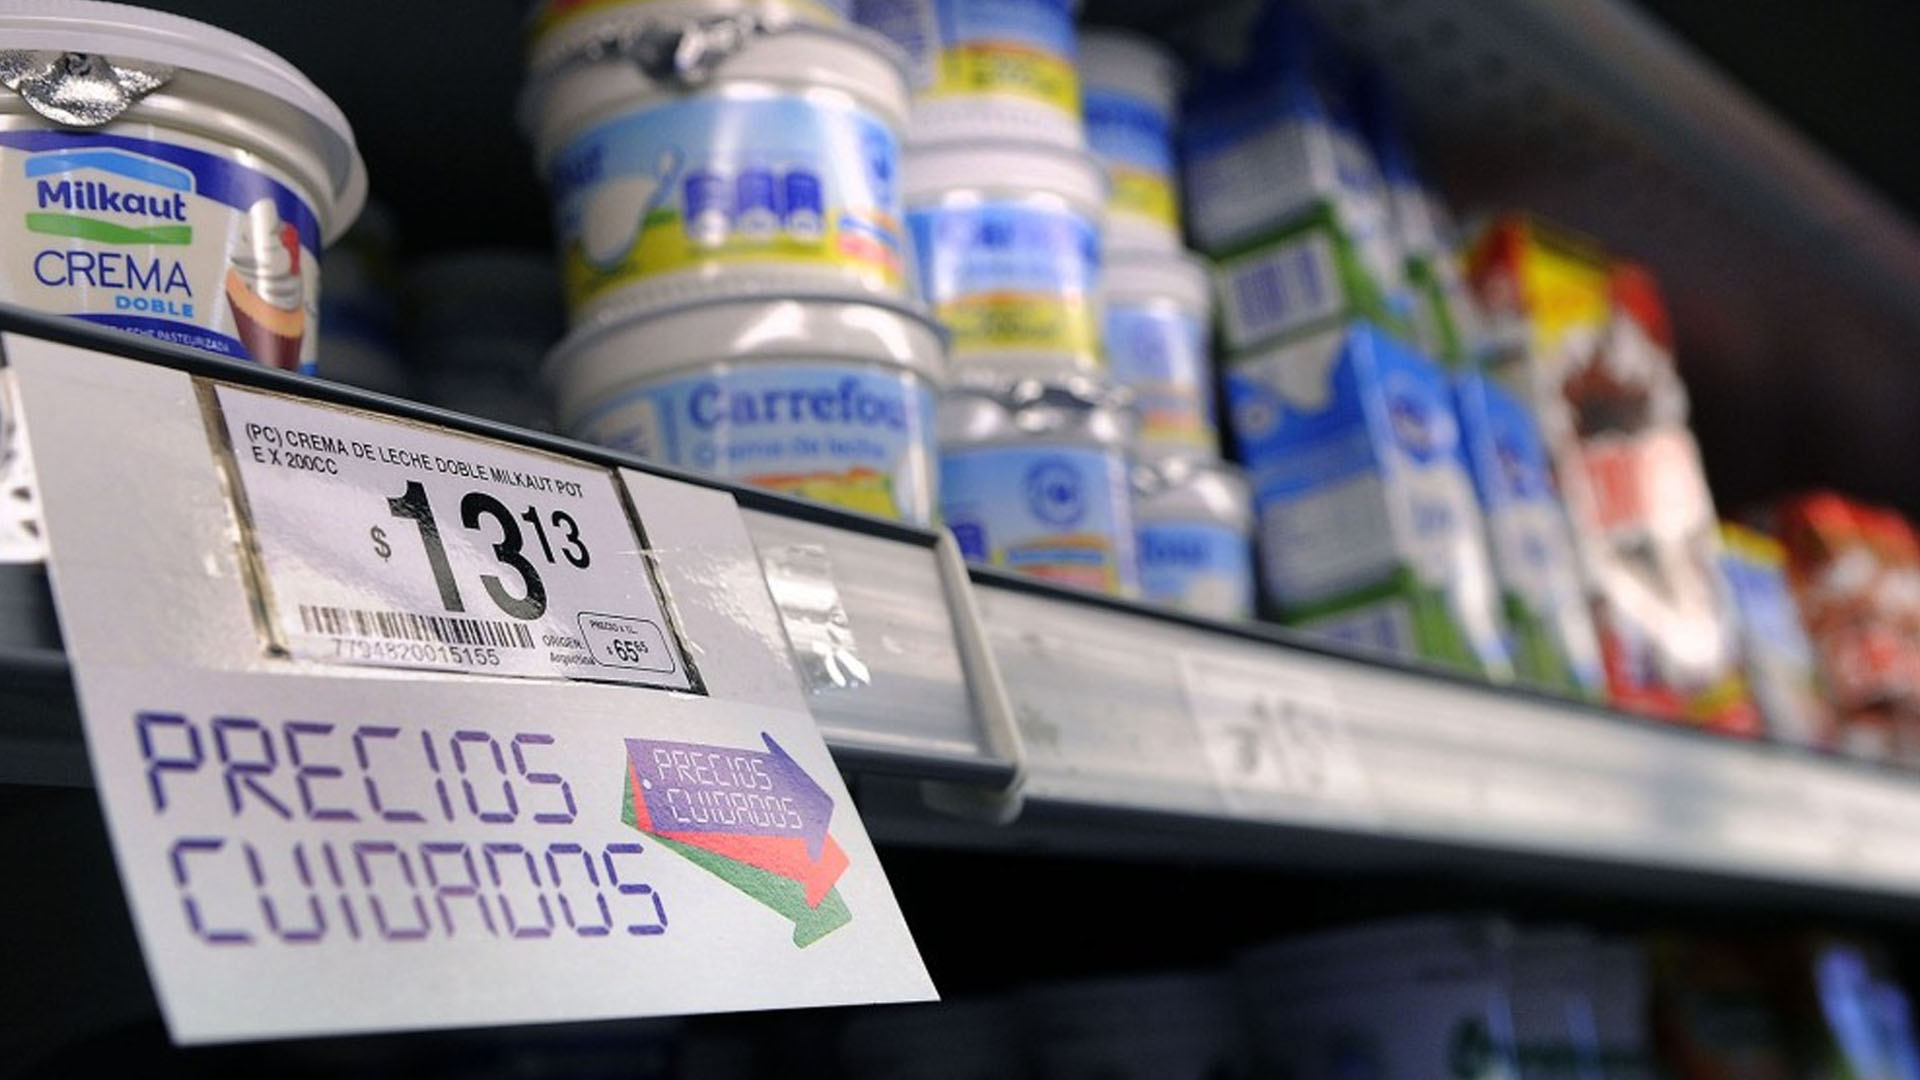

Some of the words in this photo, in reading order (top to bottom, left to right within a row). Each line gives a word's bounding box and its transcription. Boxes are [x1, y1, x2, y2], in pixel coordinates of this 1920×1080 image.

[37, 181, 187, 221] Milkaut
[34, 250, 192, 297] CREMA
[115, 296, 194, 317] DOBLE
[245, 423, 282, 447] (PC)
[285, 430, 349, 457] CREMA
[352, 442, 376, 461] DE
[378, 447, 434, 471] LECHE
[436, 457, 489, 481] DOBLE
[490, 467, 554, 493] MILKAUT
[557, 480, 584, 498] POT
[252, 446, 265, 463] E
[268, 448, 282, 466] X
[285, 452, 338, 475] 200CC
[370, 525, 392, 562] $
[331, 638, 501, 666] 7794820015155
[135, 710, 577, 825] PRECIOS
[653, 749, 773, 790] PRECIOS
[667, 789, 803, 829] CUIDADOS
[168, 837, 668, 945] CUIDADOS
